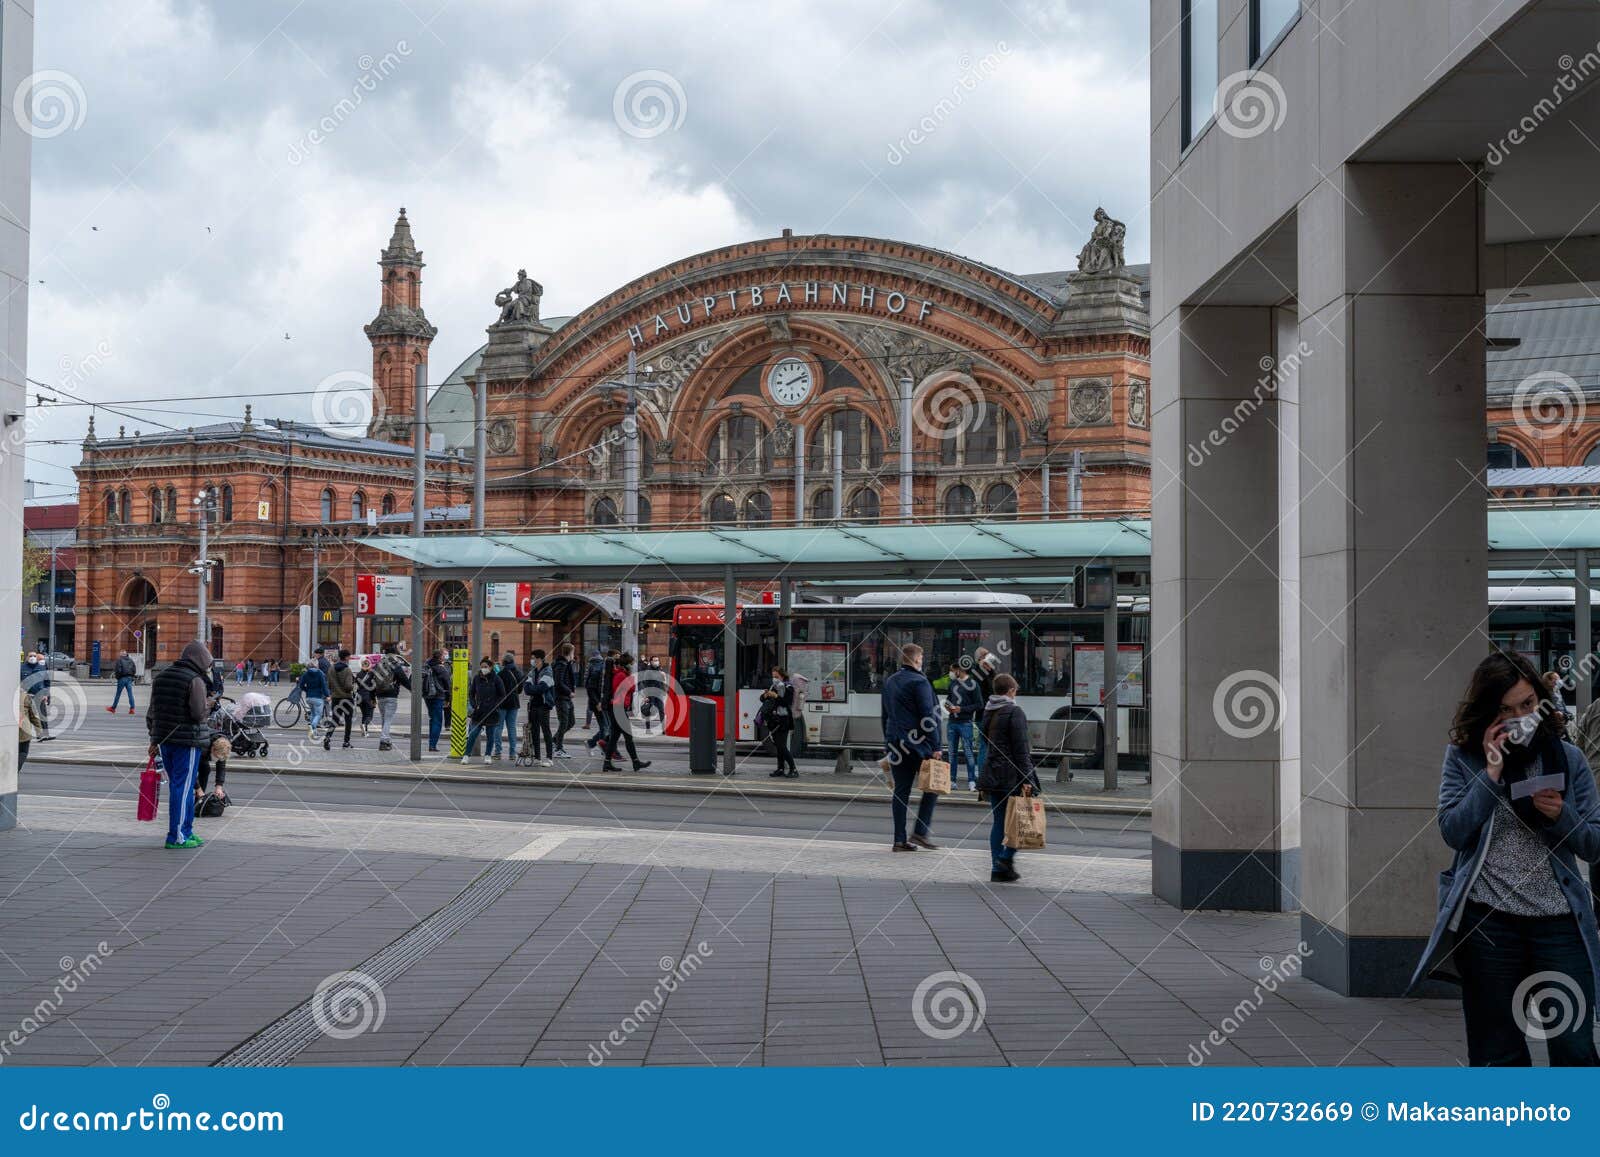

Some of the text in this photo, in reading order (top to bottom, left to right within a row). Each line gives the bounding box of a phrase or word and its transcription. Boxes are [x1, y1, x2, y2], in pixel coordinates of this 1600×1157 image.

[628, 282, 933, 347] HAUPTBAHNHOF
[358, 592, 369, 613] B
[520, 596, 530, 617] C
